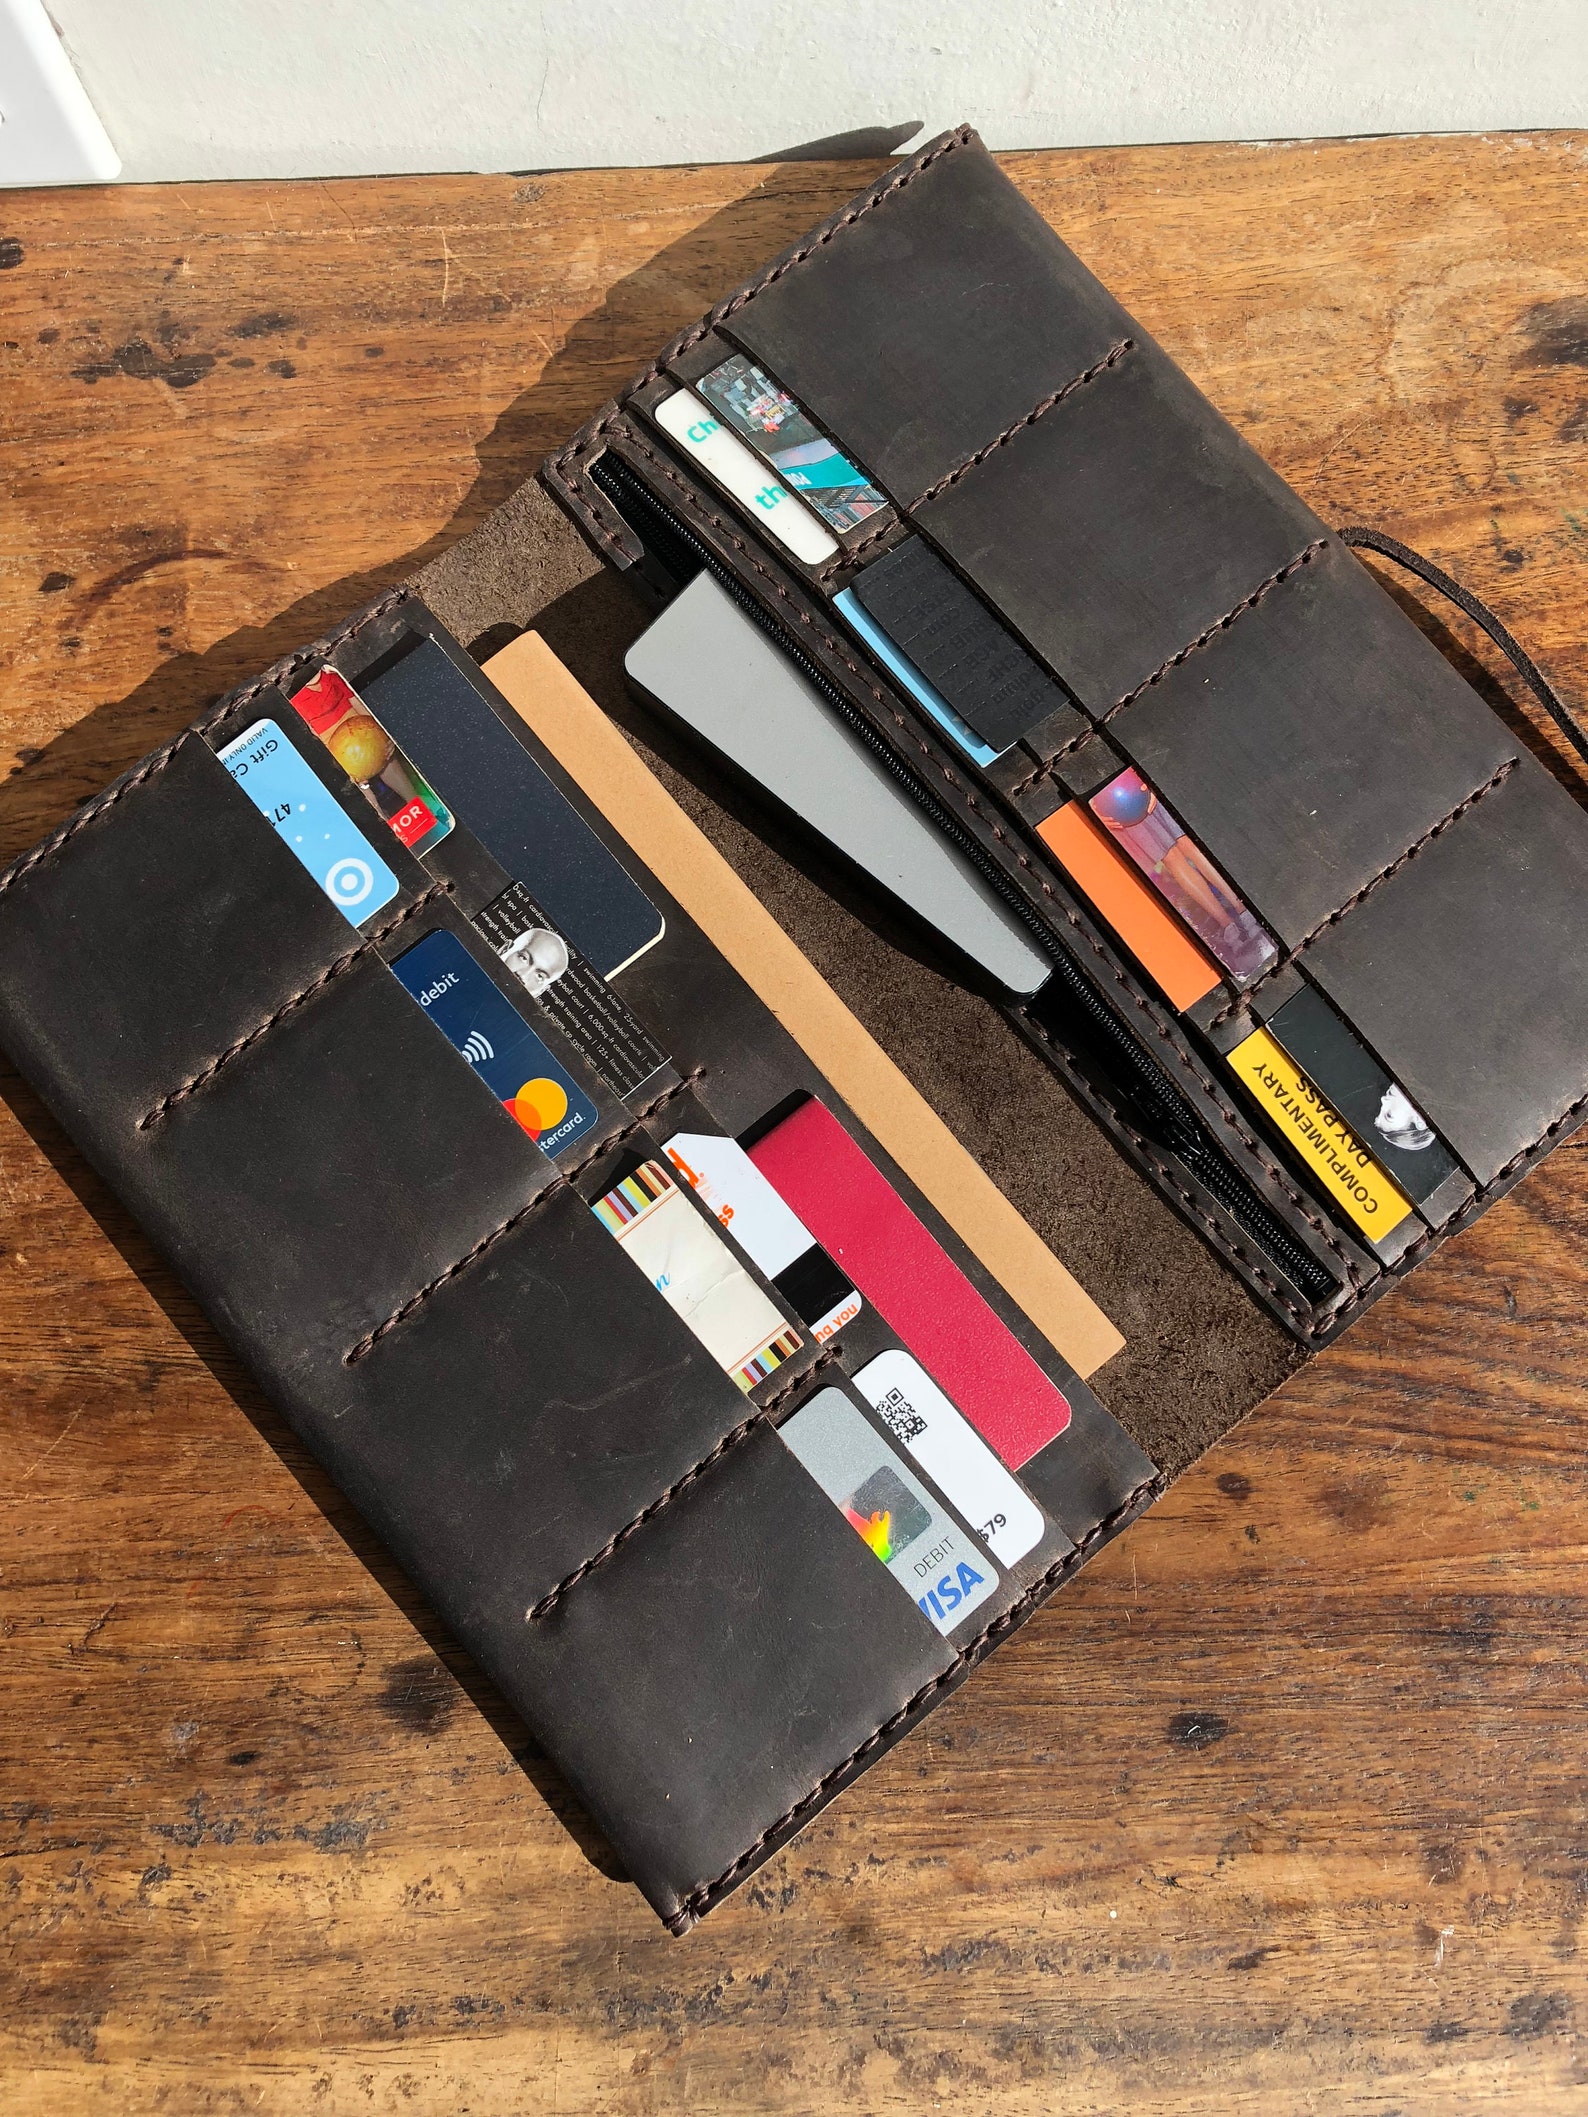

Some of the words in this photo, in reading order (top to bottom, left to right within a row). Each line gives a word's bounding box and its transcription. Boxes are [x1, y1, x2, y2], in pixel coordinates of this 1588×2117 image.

[229, 744, 248, 760] ONLY
[246, 728, 268, 747] VALID
[249, 739, 279, 764] Gift
[420, 972, 459, 1006] debit
[498, 910, 521, 934] volleyball
[571, 995, 585, 1009] court
[613, 1044, 645, 1079] cardiovascular
[507, 900, 517, 911] spa
[628, 1040, 642, 1056] courts
[583, 968, 606, 994] swimming
[623, 1013, 644, 1035] 25-yard
[564, 1007, 582, 1028] training
[581, 1027, 592, 1040] area
[1296, 1076, 1340, 1128] PASS
[1252, 1063, 1378, 1214] COMPLIMENTARY
[1335, 1126, 1372, 1168] DAY
[832, 1302, 858, 1328] you
[977, 1513, 1007, 1542] $79
[913, 1536, 954, 1578] DEBIT
